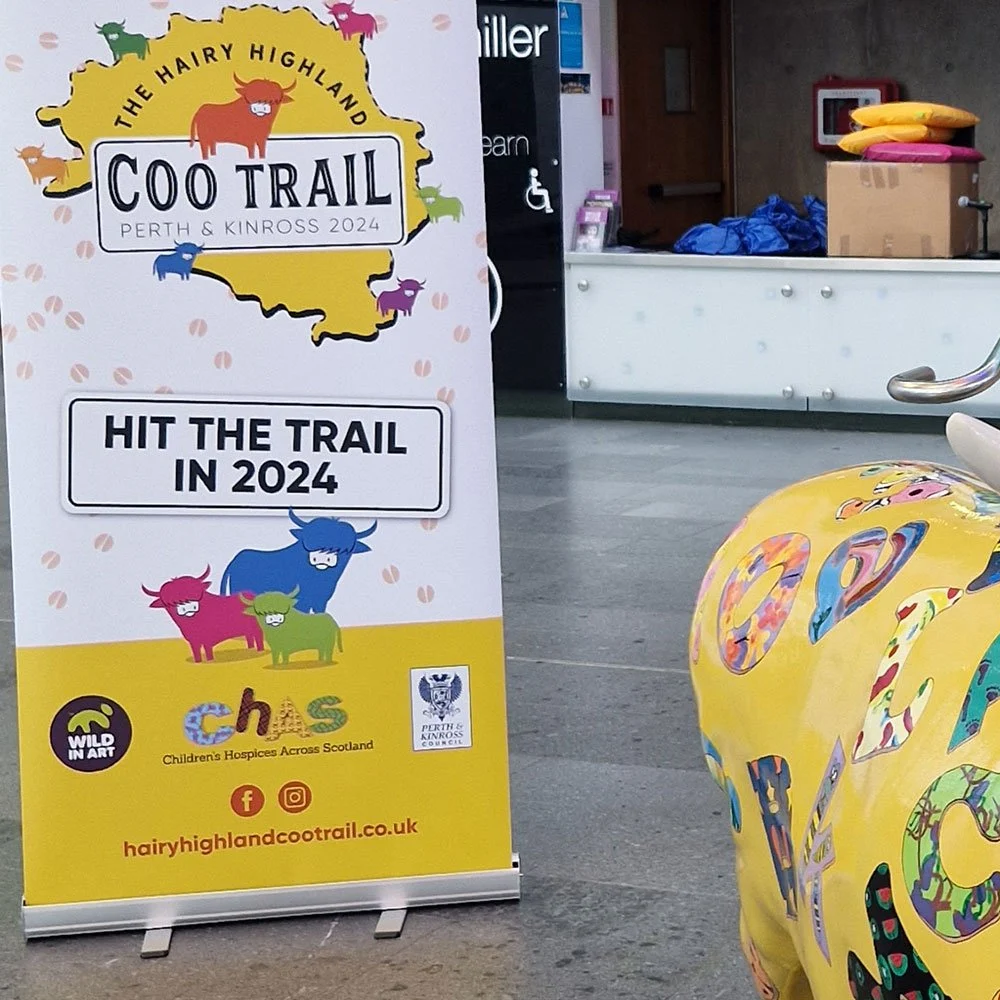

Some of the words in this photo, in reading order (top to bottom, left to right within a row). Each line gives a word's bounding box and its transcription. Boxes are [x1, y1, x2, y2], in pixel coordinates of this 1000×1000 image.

[114, 84, 154, 129] THE
[155, 43, 233, 84] HAIRY
[250, 43, 368, 127] HIGHLAND
[107, 153, 218, 212] COO
[235, 149, 392, 209] TRAIL
[120, 221, 191, 239] PERTH
[202, 221, 214, 237] &
[225, 219, 320, 236] KINROSS
[330, 217, 380, 233] 2024
[105, 415, 175, 449] HIT
[189, 417, 270, 451] THE
[285, 419, 407, 455] TRAIL
[174, 459, 217, 492] IN
[232, 460, 338, 494] 2024
[421, 723, 454, 732] PERTH
[421, 731, 464, 740] KINROSS
[68, 733, 115, 748] WILD
[163, 752, 221, 765] Children's
[224, 749, 278, 762] Hospices
[280, 746, 320, 757] Across
[323, 740, 374, 753] Scotland
[68, 749, 84, 760] IN
[87, 747, 115, 759] ART
[123, 818, 418, 858] hairyhighlandcootrail.co.uk
